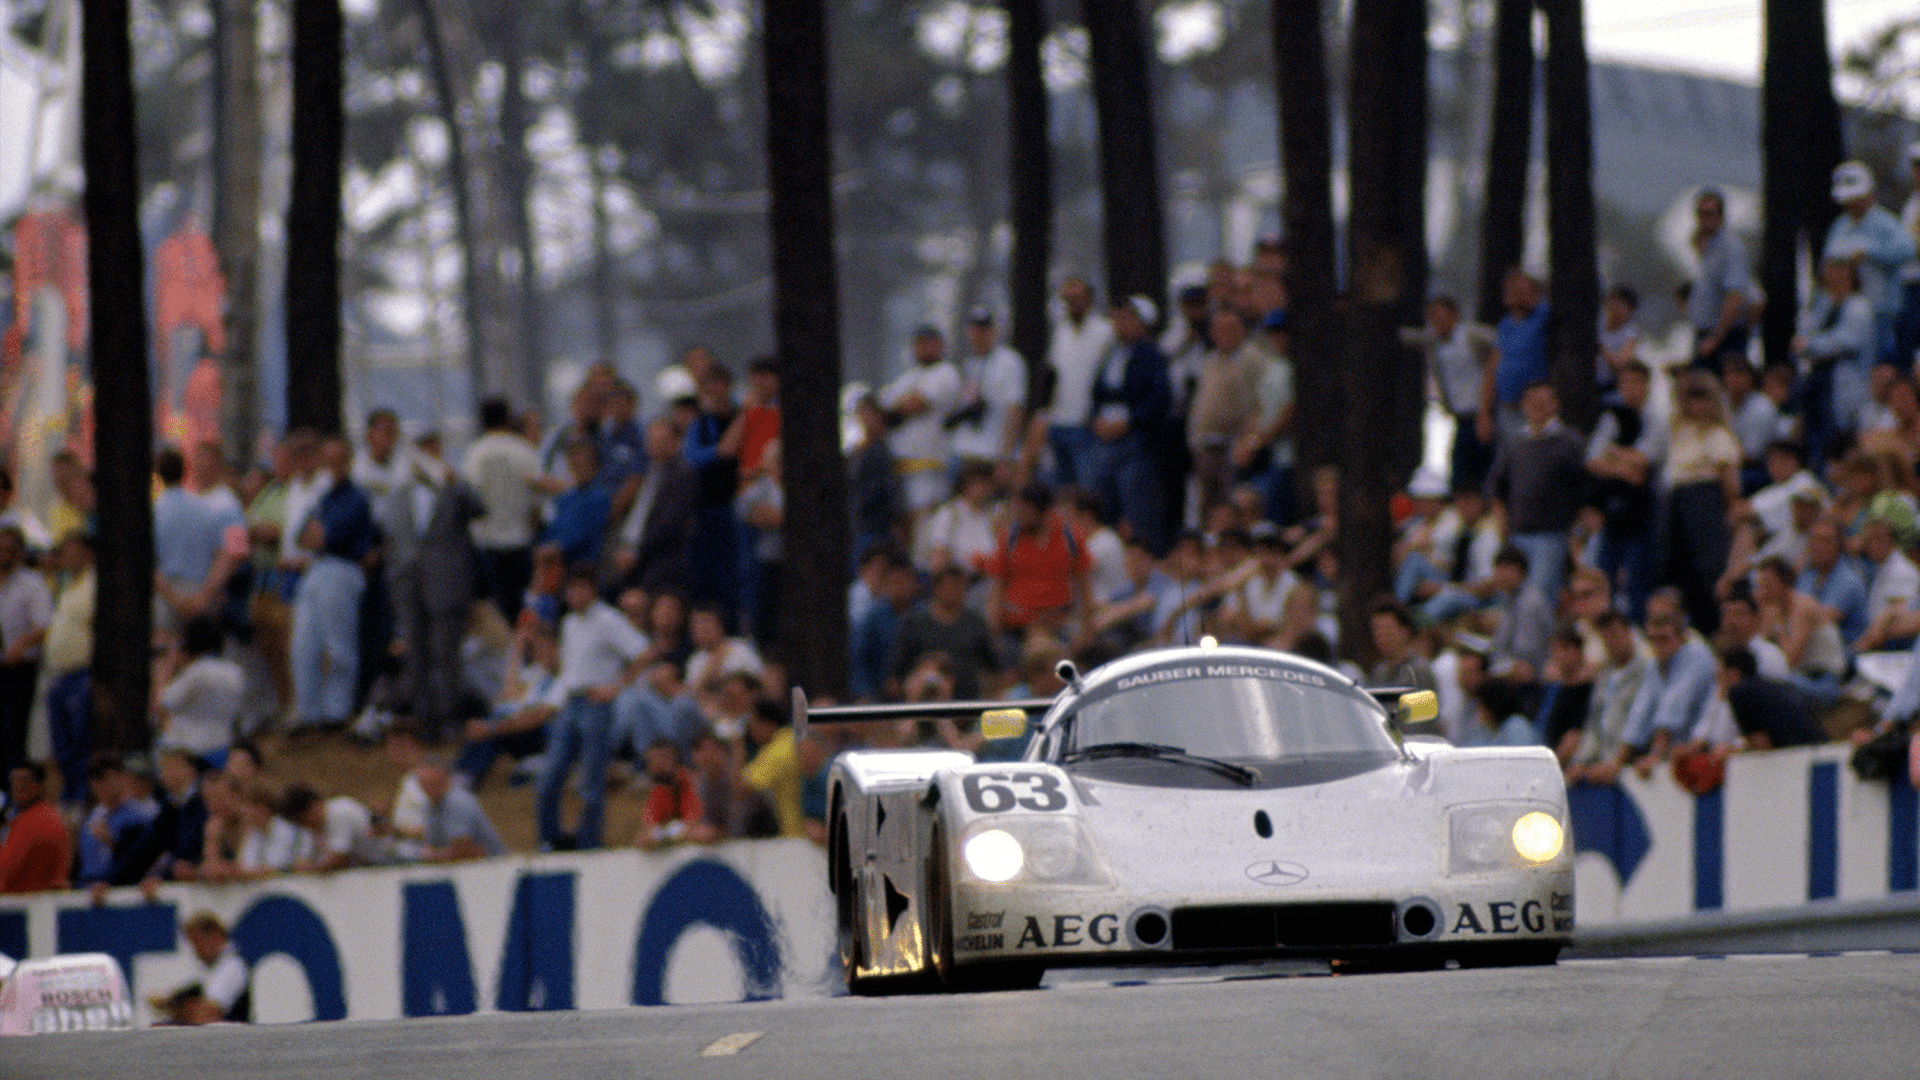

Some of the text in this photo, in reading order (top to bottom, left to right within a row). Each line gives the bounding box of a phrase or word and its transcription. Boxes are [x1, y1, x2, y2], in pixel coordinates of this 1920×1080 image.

[1117, 665, 1326, 690] SAUBER MERCEDES
[962, 772, 1068, 814] 63
[1016, 913, 1119, 949] AEG
[1451, 900, 1546, 934] AEG
